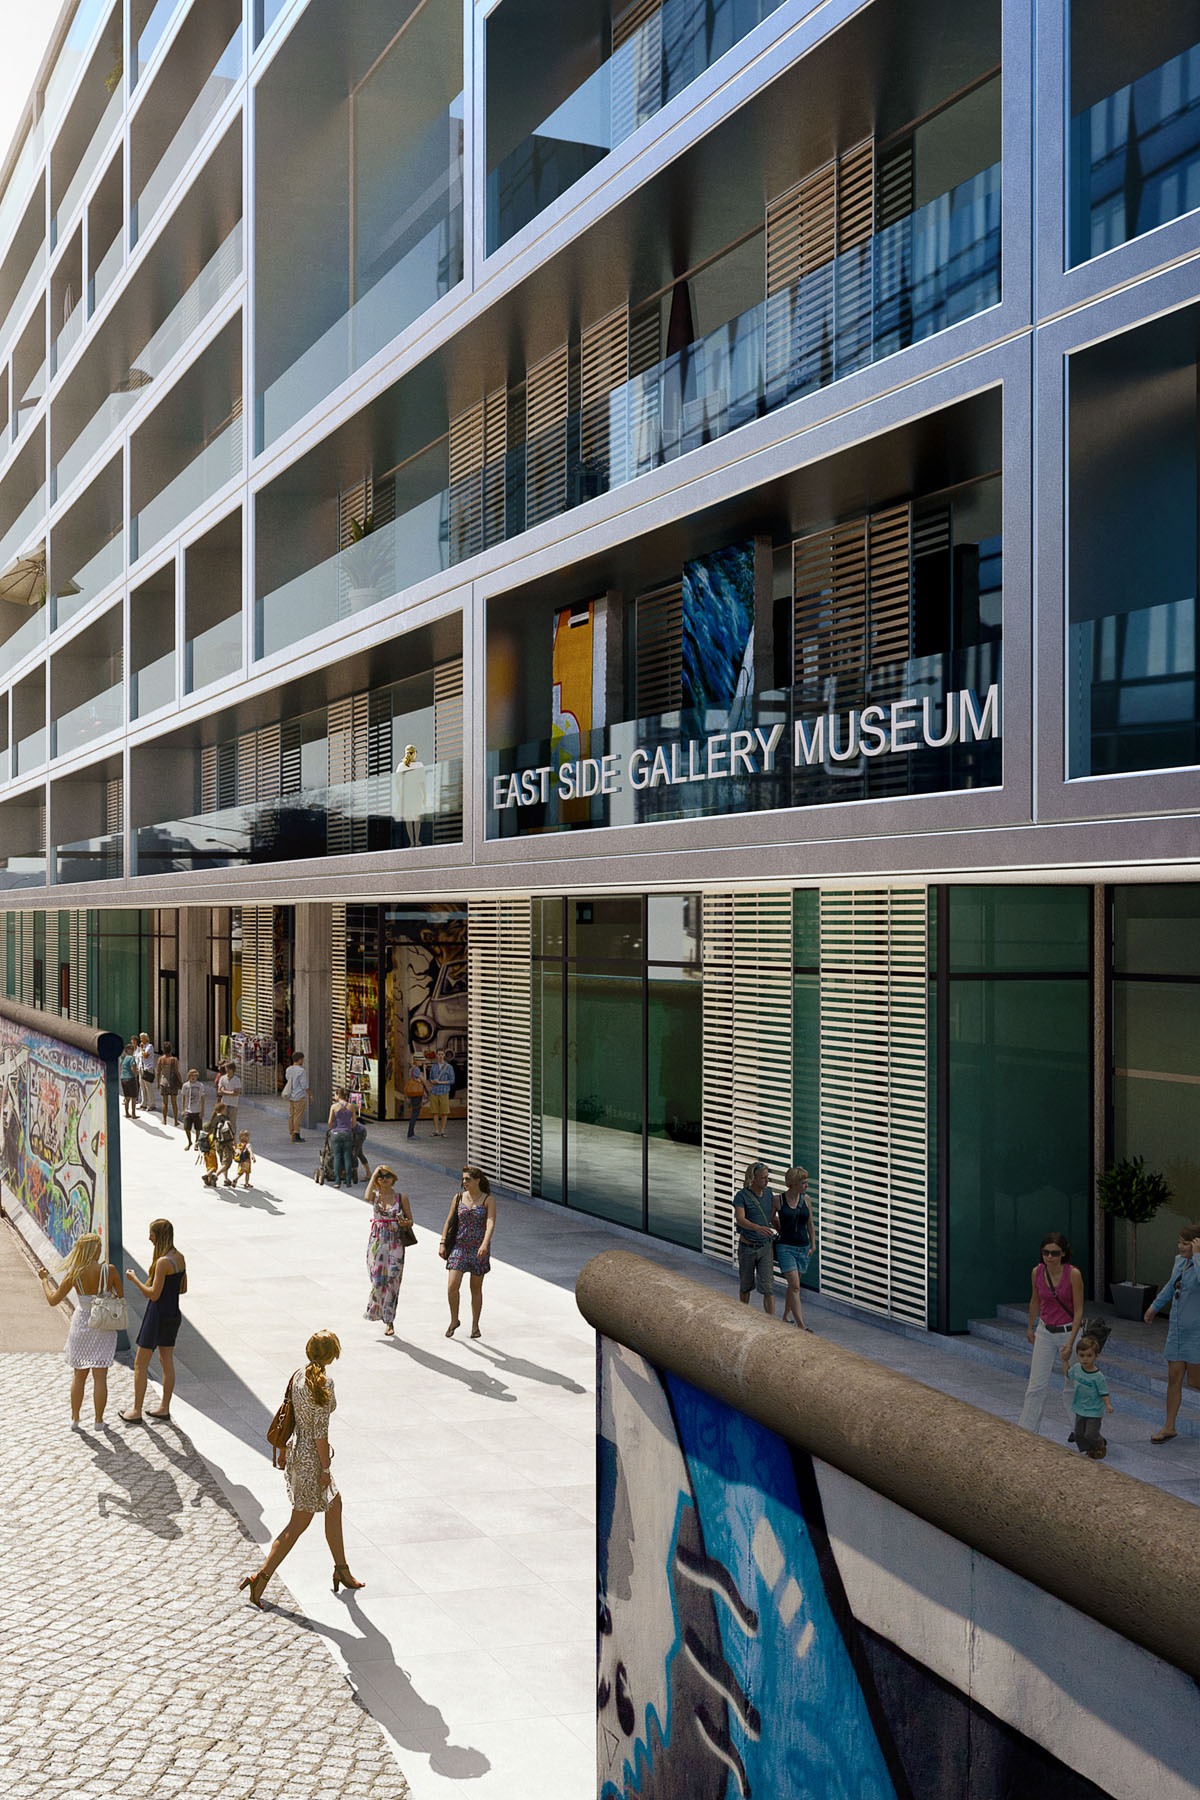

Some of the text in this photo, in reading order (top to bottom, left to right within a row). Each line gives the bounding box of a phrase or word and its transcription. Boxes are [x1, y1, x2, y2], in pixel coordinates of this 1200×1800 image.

[493, 683, 1001, 810] EAST SIDE GALLERY MUSEUM
